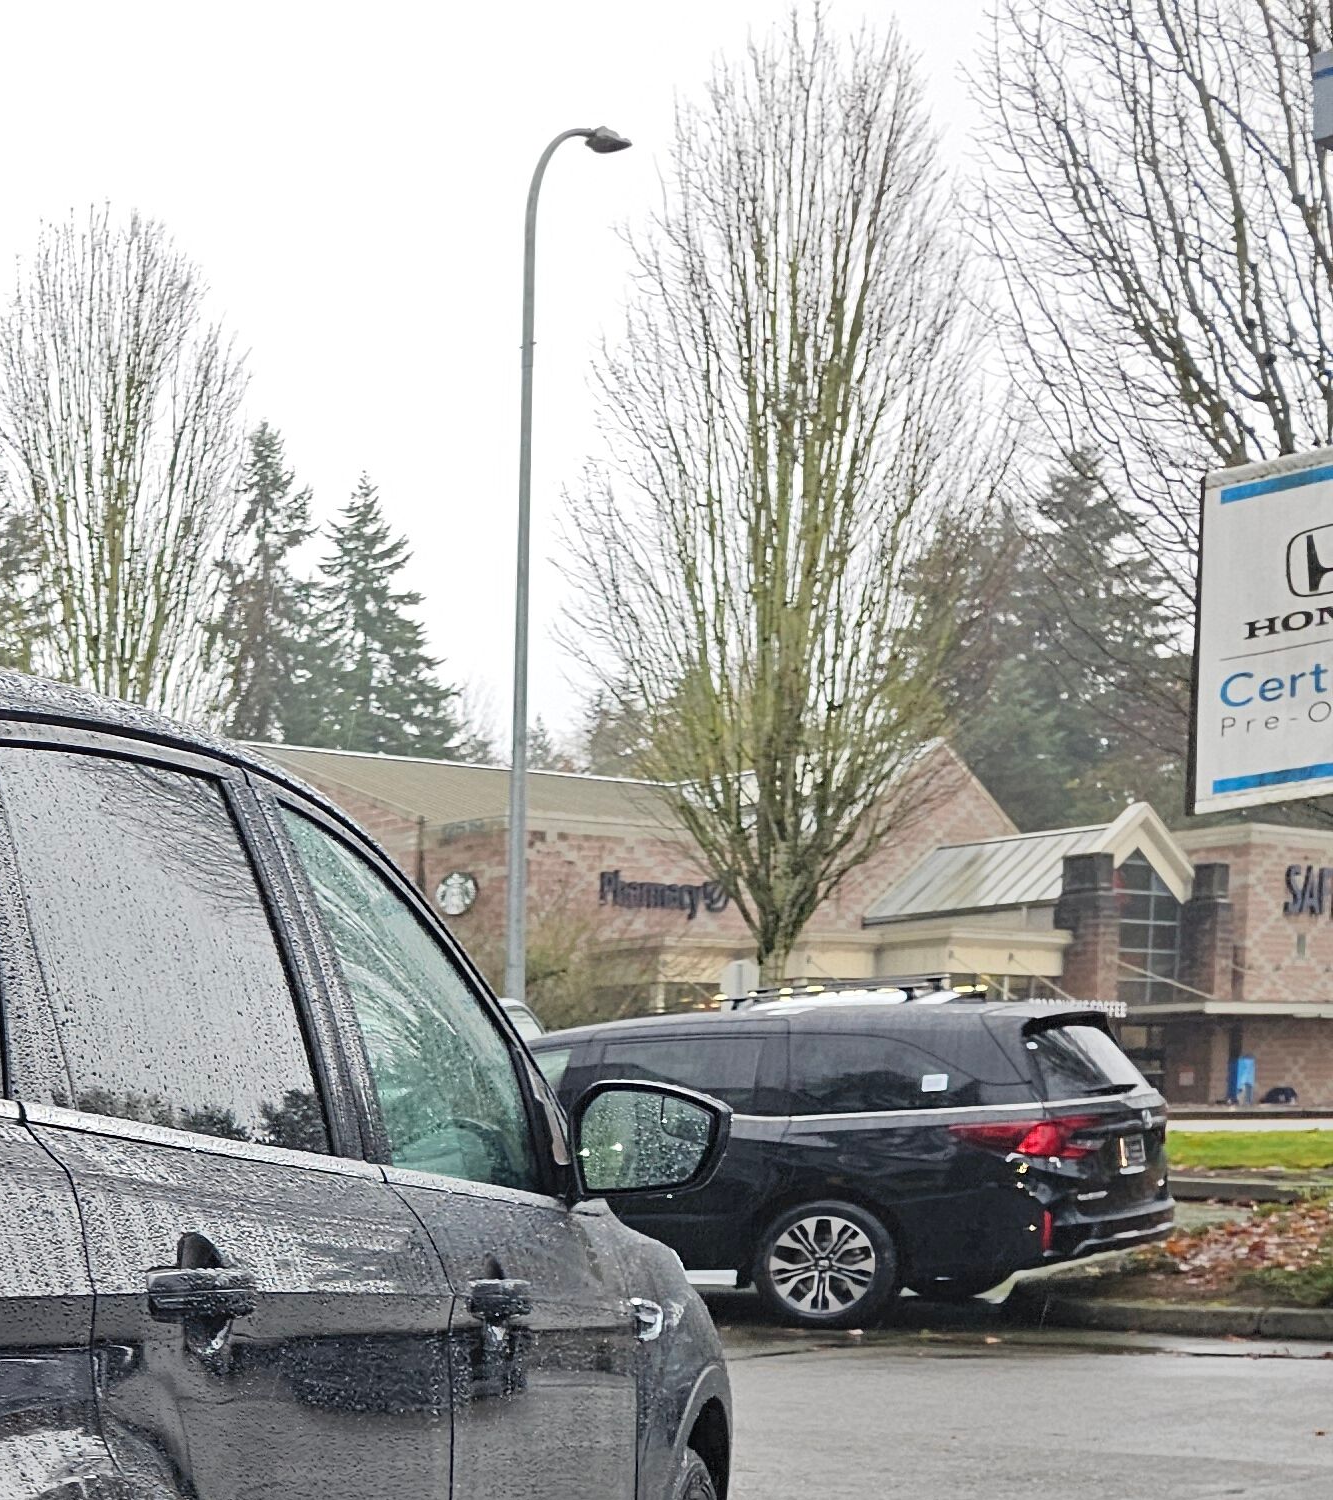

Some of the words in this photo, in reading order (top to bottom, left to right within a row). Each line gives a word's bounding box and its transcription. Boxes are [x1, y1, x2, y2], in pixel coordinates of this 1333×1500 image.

[1220, 663, 1328, 707] Cert
[1221, 701, 1332, 737] Pre-O
[599, 870, 701, 920] Pharmacy
